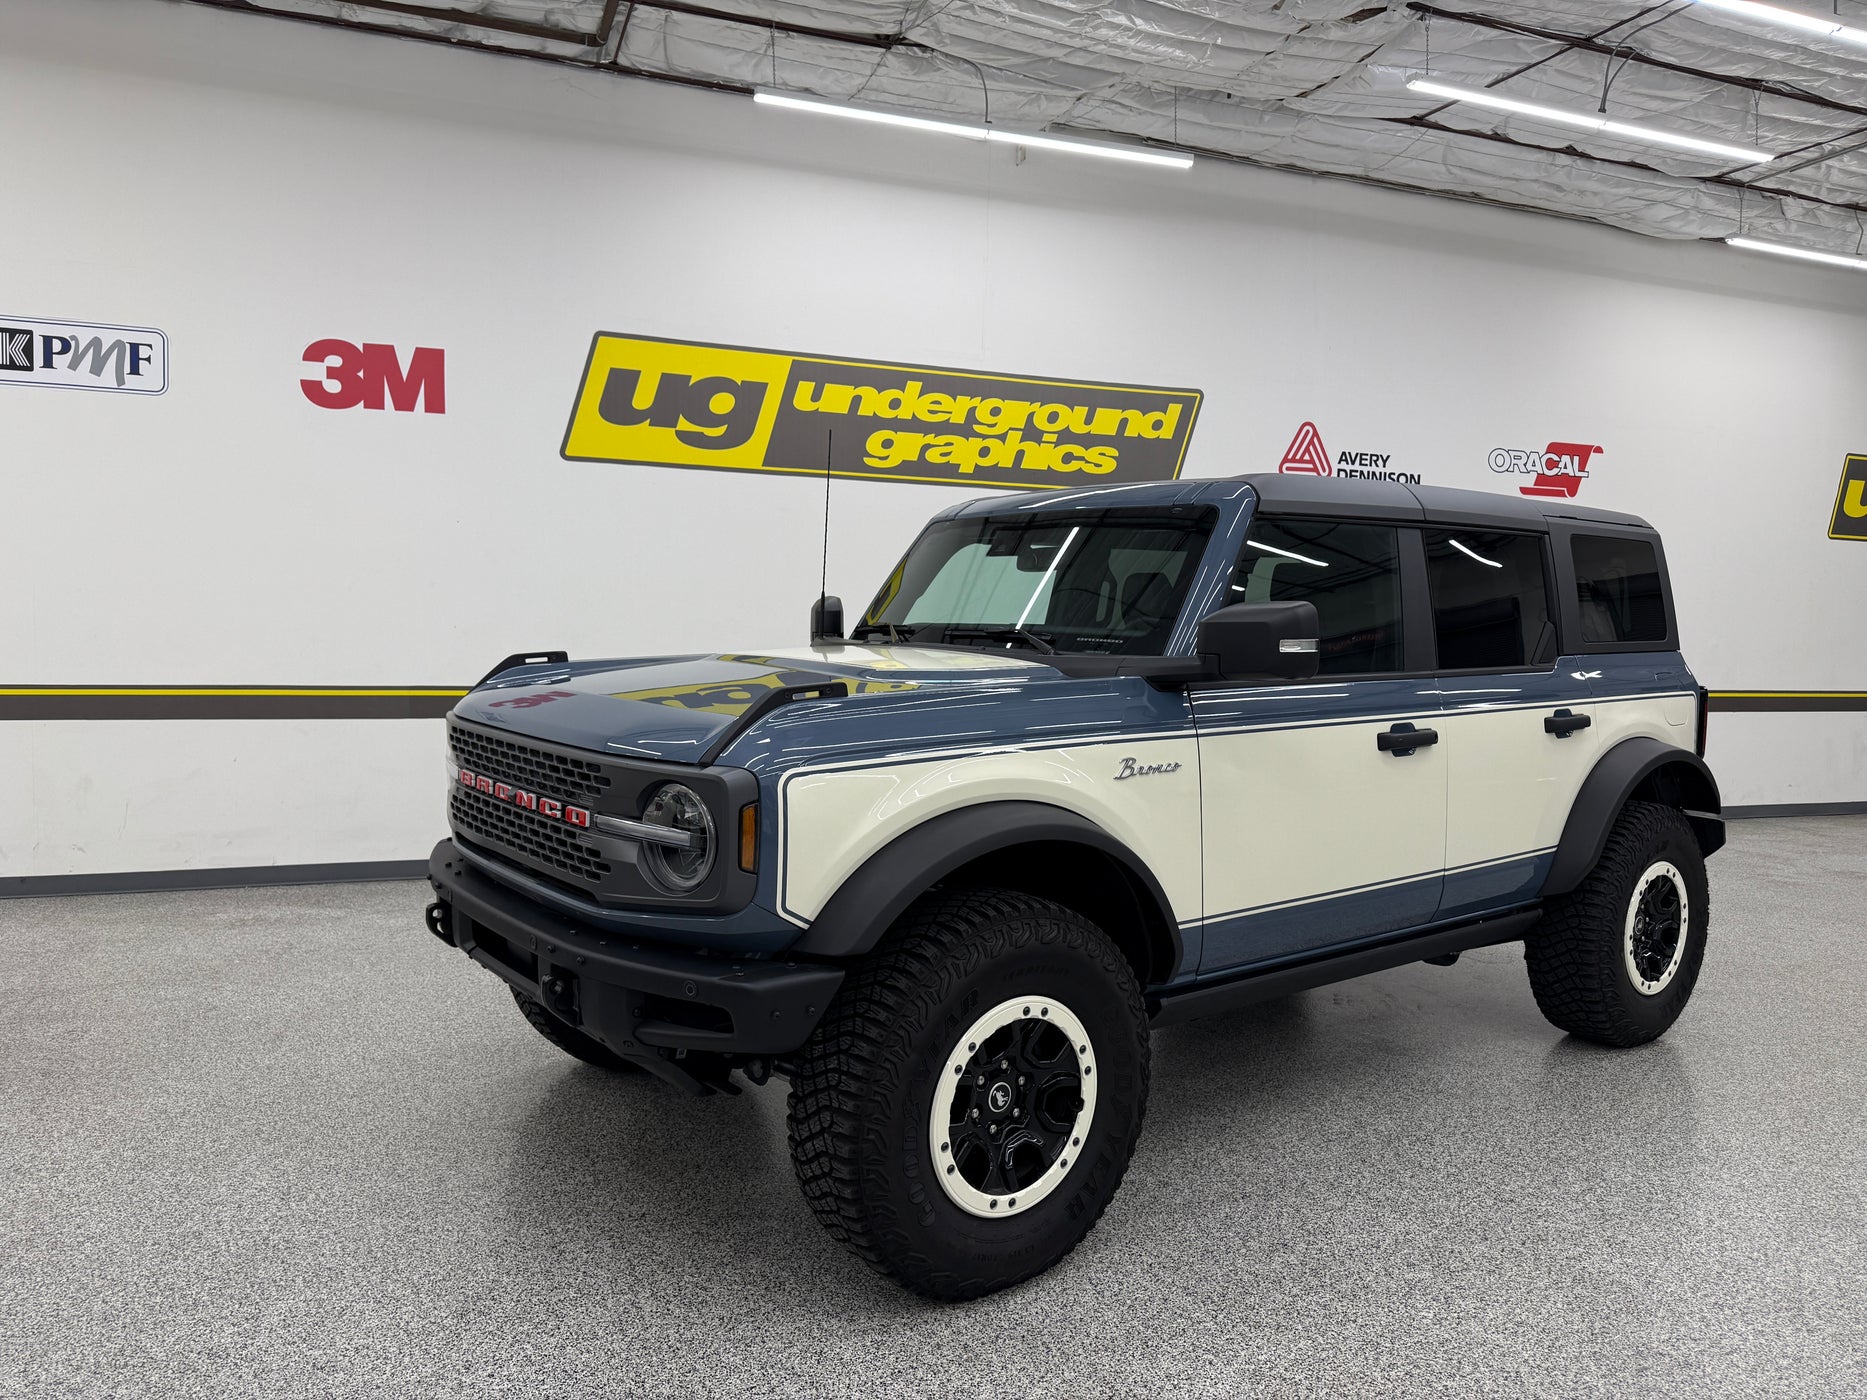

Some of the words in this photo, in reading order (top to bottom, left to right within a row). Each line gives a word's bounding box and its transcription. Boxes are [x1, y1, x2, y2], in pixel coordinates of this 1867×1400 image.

[300, 338, 446, 414] 3M
[598, 366, 769, 451] ug
[792, 380, 1184, 440] underground
[862, 429, 1119, 474] graphics
[1337, 451, 1391, 468] AVERY
[1488, 447, 1589, 478] ORACAL
[1113, 757, 1182, 780] Bronco
[460, 769, 590, 828] BRONCO
